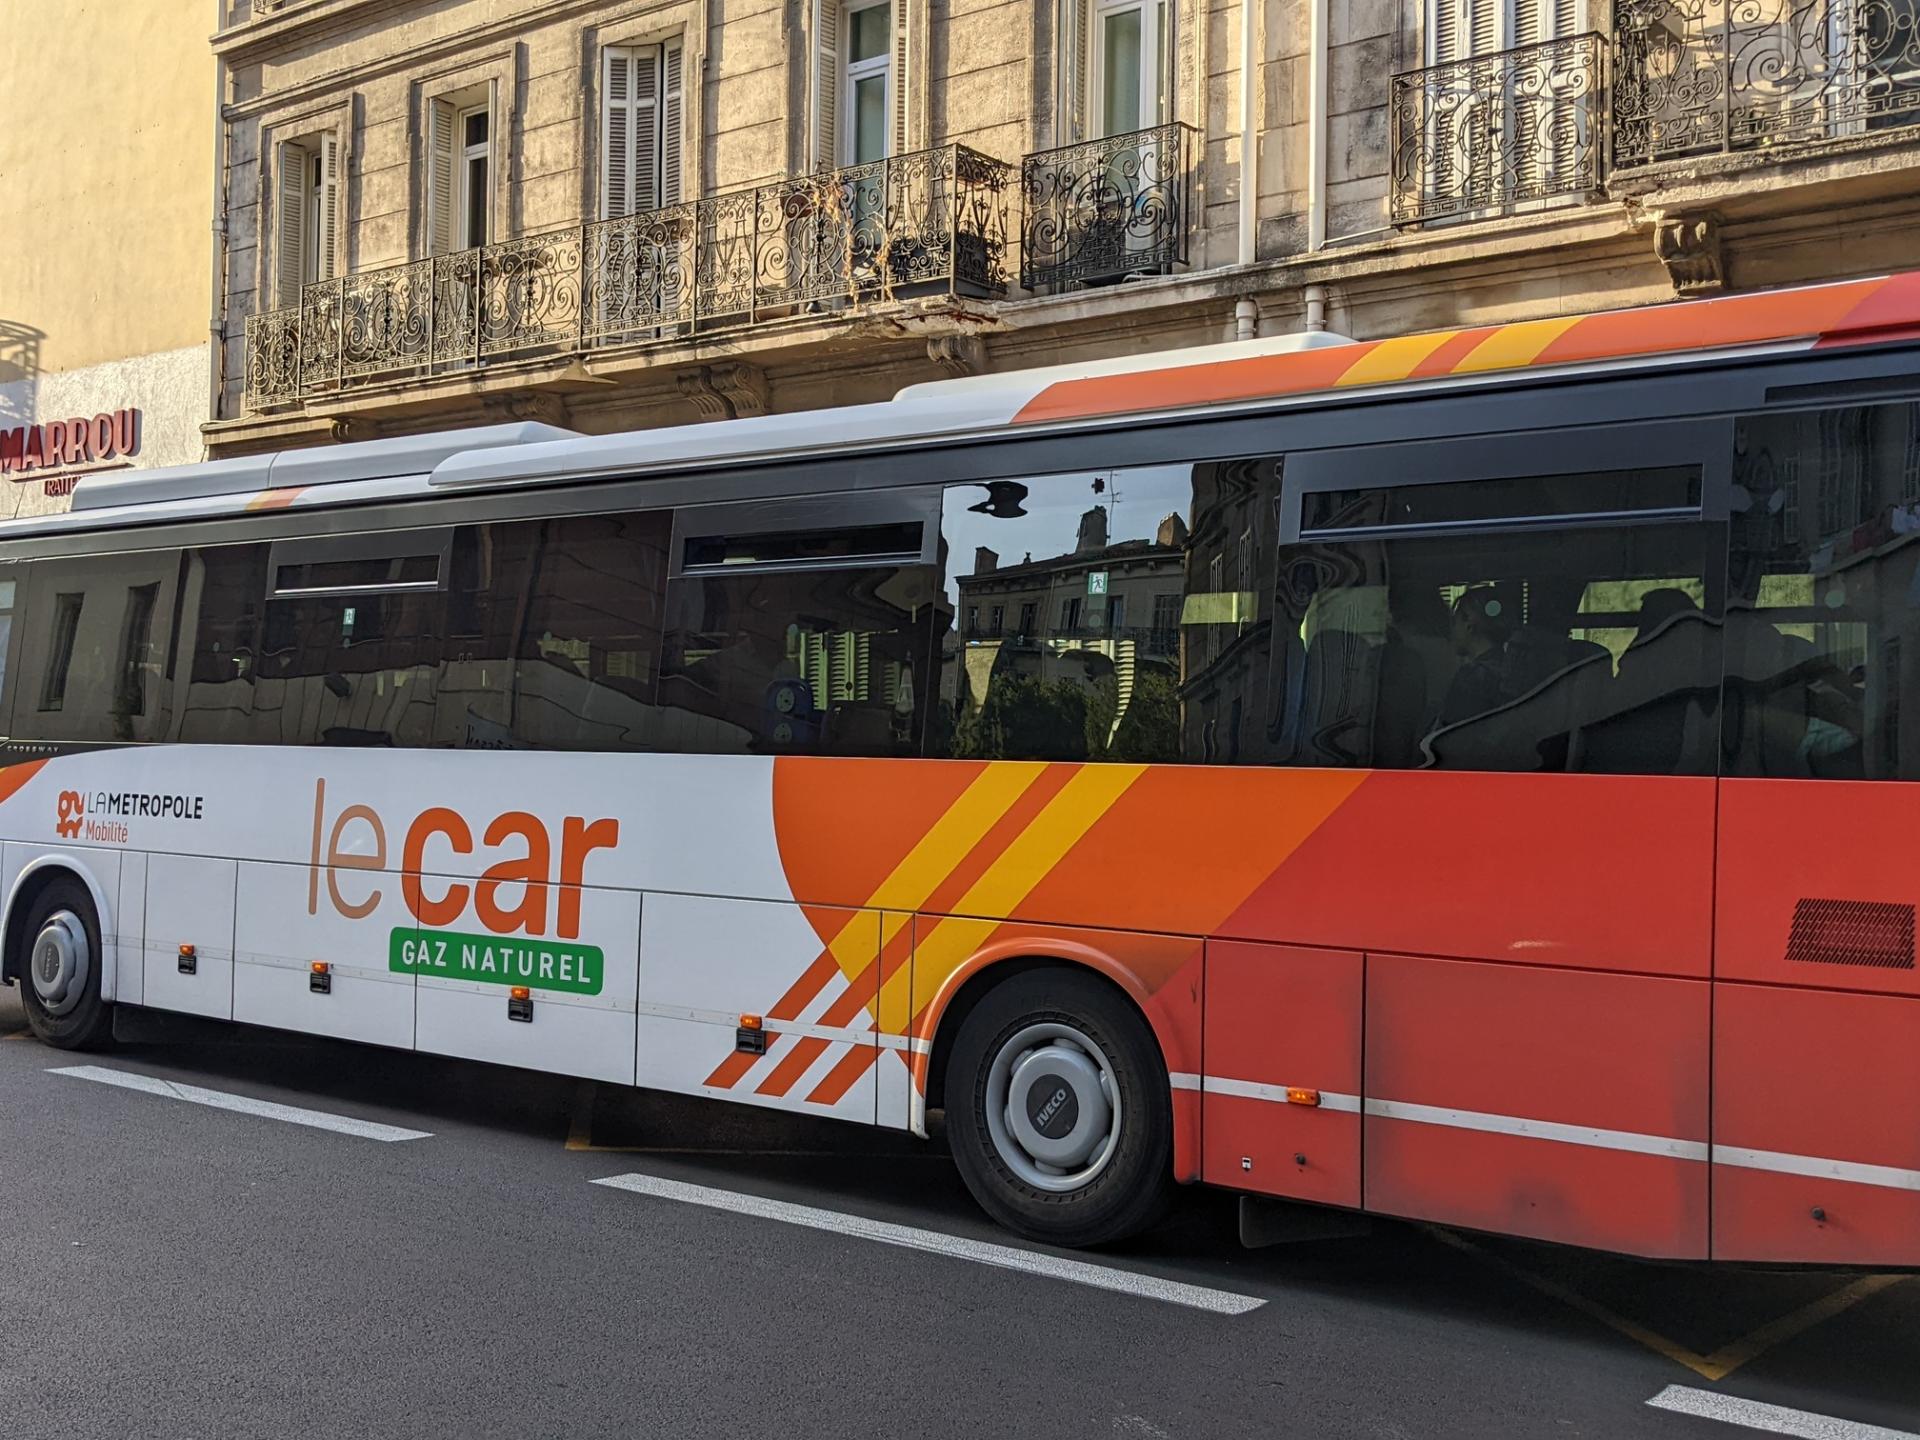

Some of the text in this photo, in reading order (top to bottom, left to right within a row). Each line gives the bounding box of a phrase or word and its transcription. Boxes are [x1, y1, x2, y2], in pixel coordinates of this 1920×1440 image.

[0, 408, 135, 473] MARROU
[86, 820, 129, 843] Mobilité
[402, 940, 591, 984] GAZ NATUREL
[1036, 1088, 1067, 1127] IVECO
